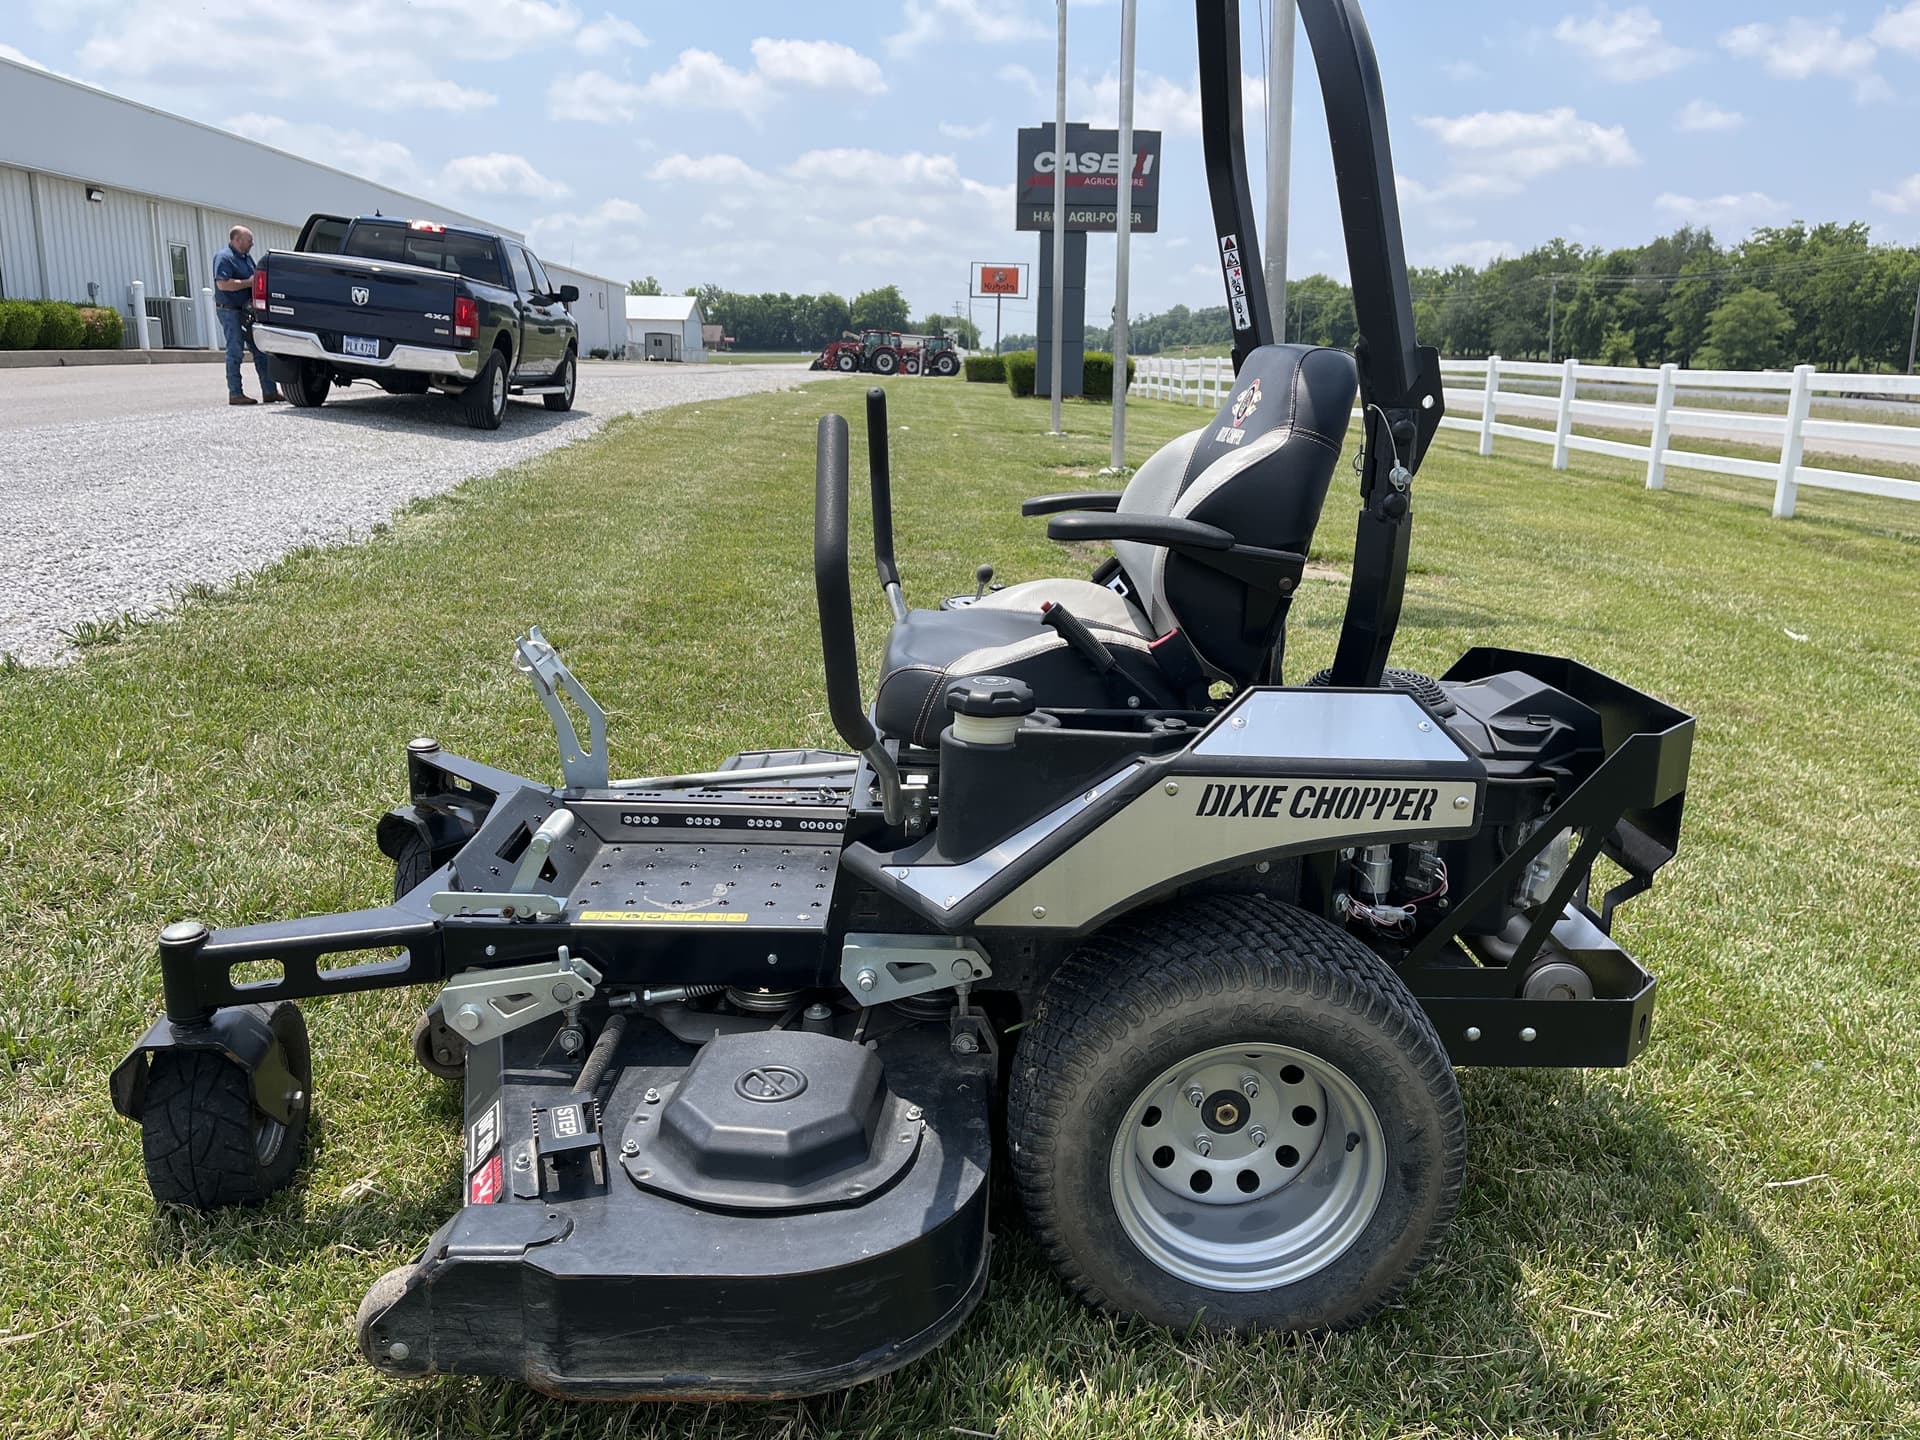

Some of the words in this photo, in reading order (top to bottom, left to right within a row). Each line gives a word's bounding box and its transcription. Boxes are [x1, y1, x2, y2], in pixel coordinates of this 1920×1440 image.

[1084, 177, 1144, 187] AGRICURE
[1033, 211, 1056, 222] H&
[1069, 211, 1142, 223] AGRI-POER
[1195, 783, 1288, 818] DIXIE
[1289, 785, 1439, 821] CHOPPER
[1231, 1002, 1409, 1083] MASTER
[557, 1107, 577, 1135] STEP
